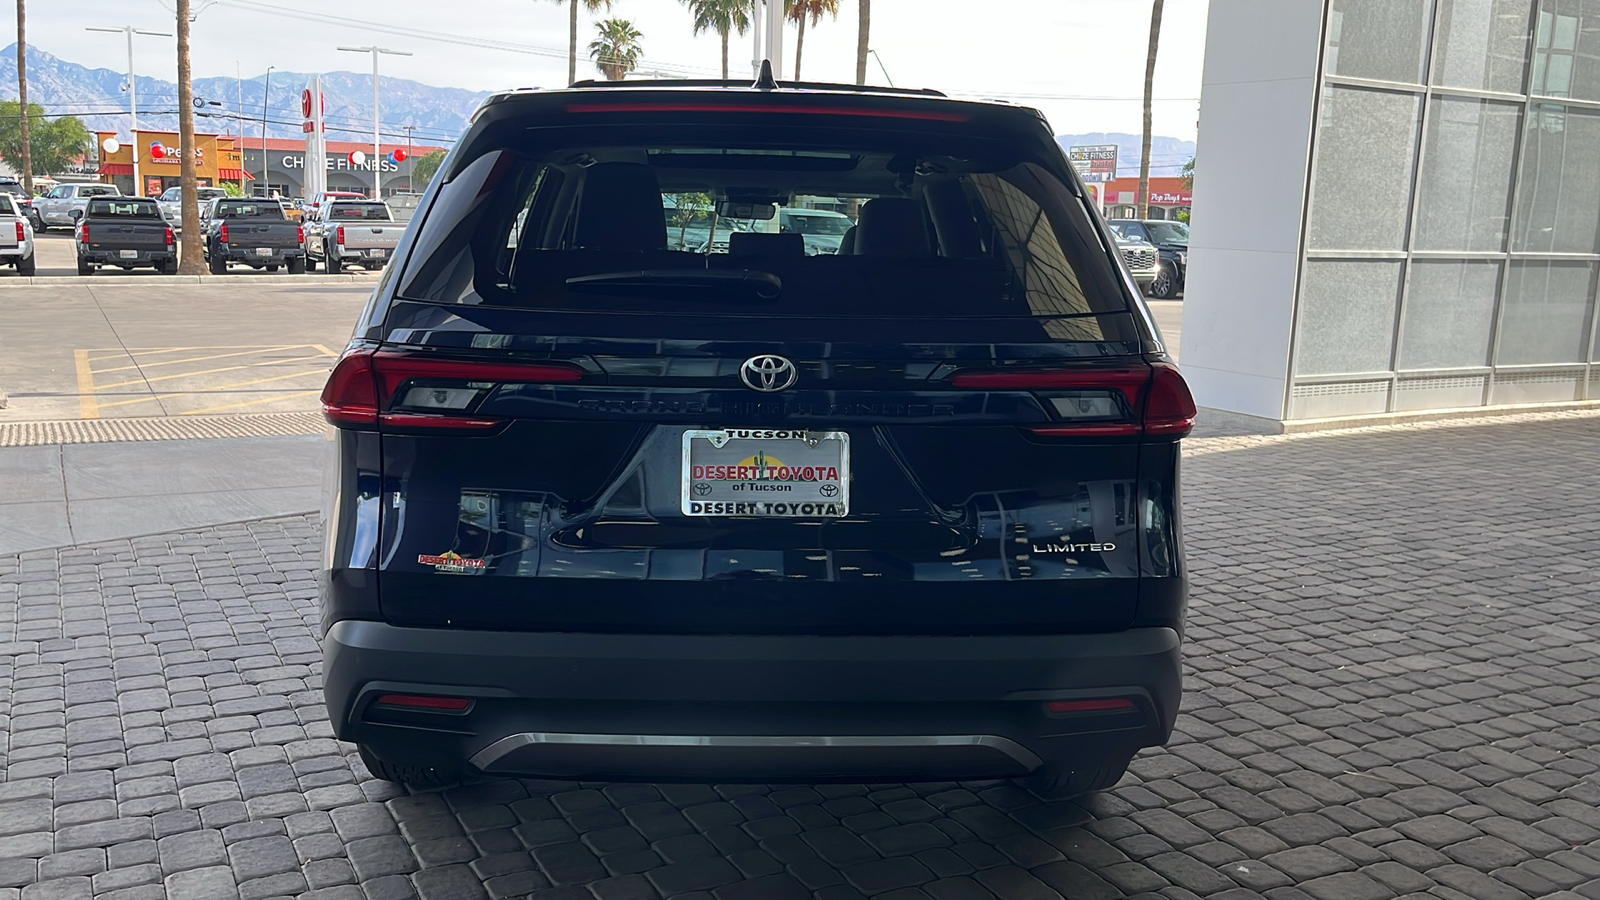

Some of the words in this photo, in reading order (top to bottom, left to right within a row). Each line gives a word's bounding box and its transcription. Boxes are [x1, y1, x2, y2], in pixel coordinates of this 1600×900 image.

[1090, 152, 1114, 160] FITNESS
[282, 155, 335, 170] CHE
[726, 430, 805, 439] TUCSON
[692, 465, 760, 480] DESERT
[767, 466, 839, 481] TOYOTA
[732, 482, 745, 492] of
[748, 483, 792, 493] Tucson
[691, 502, 757, 515] DESERT
[764, 503, 838, 516] TOYOTA
[1033, 542, 1117, 553] LIMITED
[419, 555, 448, 565] DESERT
[452, 558, 485, 569] TOYOTA
